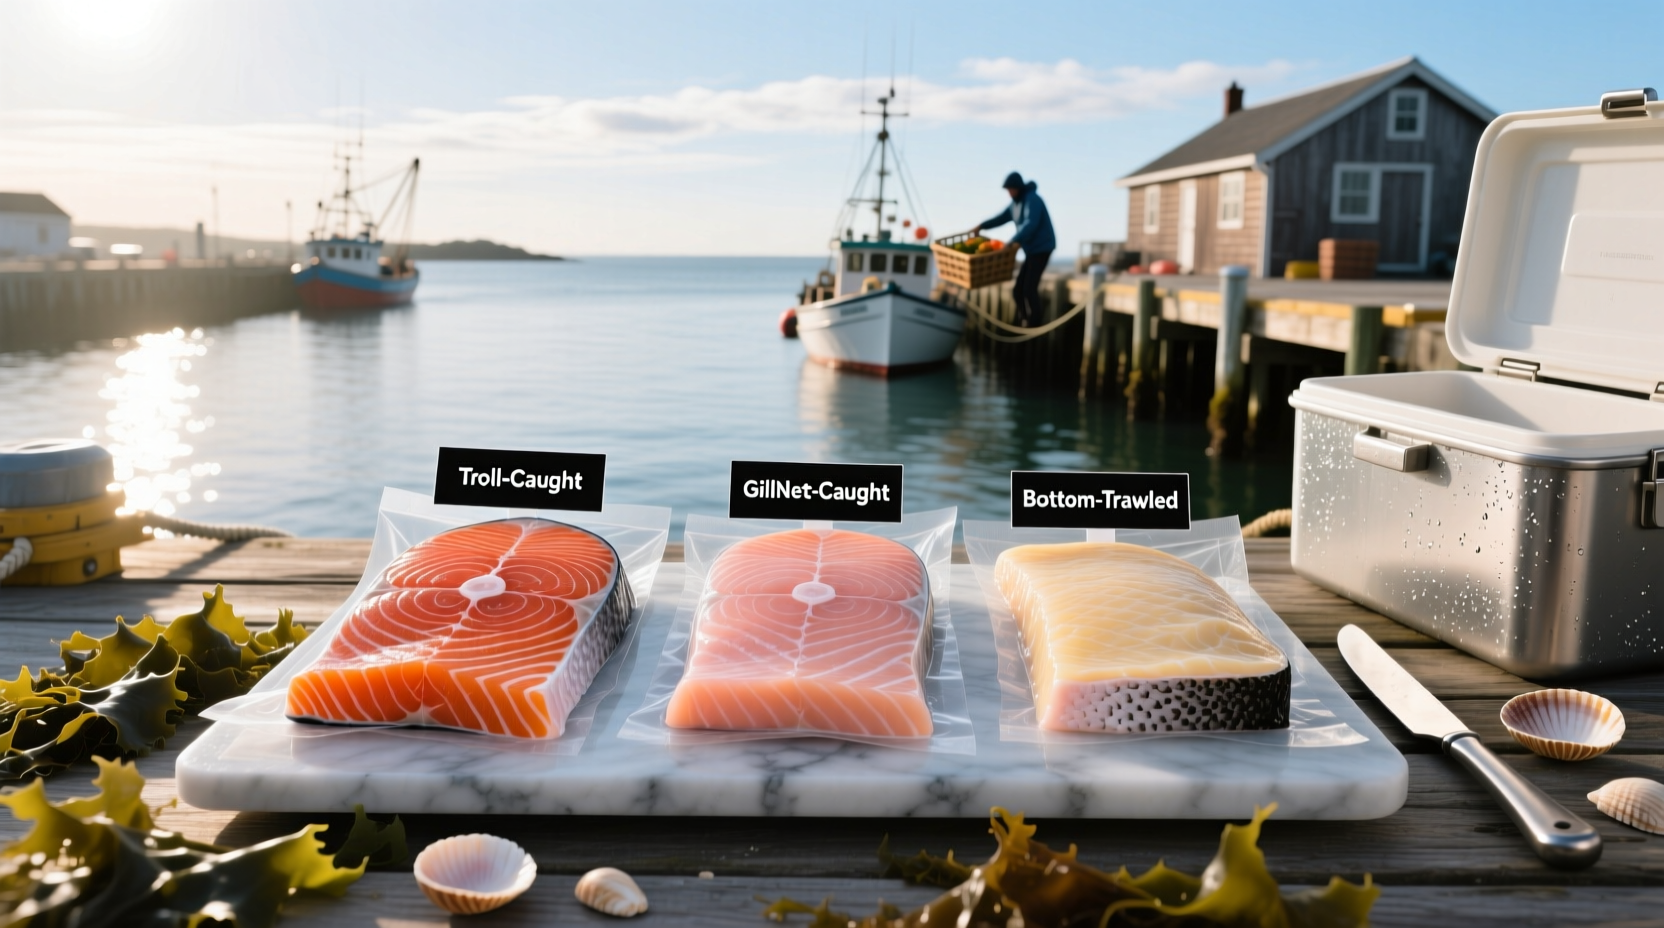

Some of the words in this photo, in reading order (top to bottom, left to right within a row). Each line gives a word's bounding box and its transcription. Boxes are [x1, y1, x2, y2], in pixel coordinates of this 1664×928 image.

[458, 466, 583, 495] Troll-Caught
[743, 479, 890, 507] GillNet-Caught
[1023, 488, 1179, 510] Bottom-Trawled
